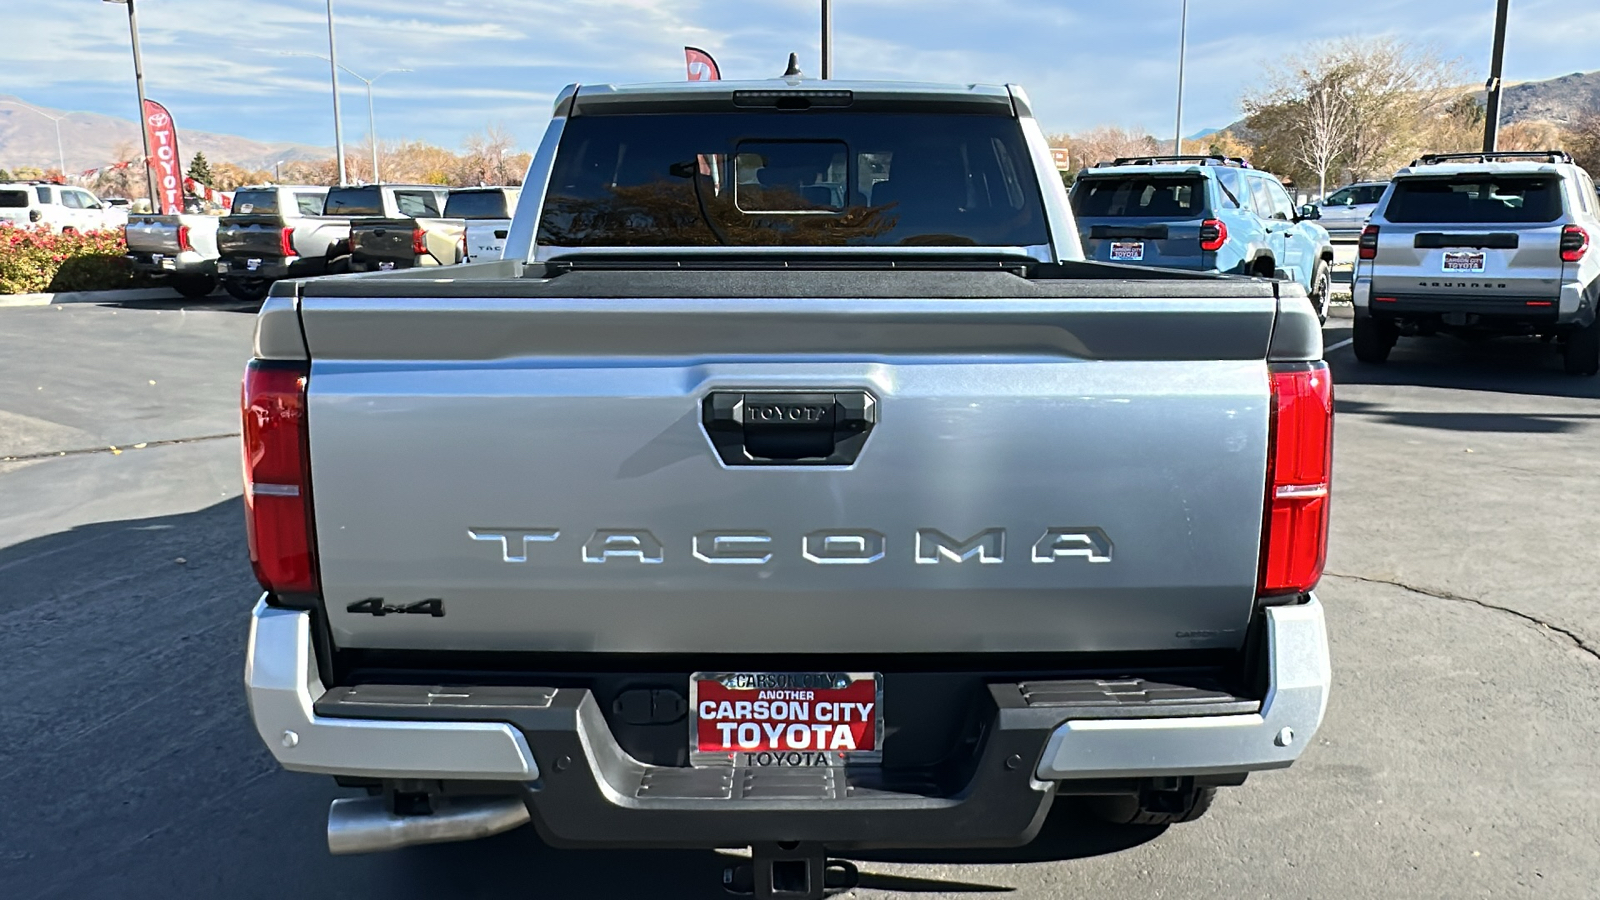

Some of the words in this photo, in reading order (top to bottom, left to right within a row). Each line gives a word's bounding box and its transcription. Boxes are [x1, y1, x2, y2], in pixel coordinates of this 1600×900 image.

[155, 131, 181, 215] TOYOTA
[747, 406, 827, 421] TOYOTA
[467, 526, 1115, 564] TACOMA
[736, 673, 797, 688] CARSON
[758, 690, 815, 700] ANOTHER
[699, 701, 809, 720] CARSON
[815, 702, 874, 722] CITY
[716, 722, 857, 750] TOYOTA
[744, 752, 828, 766] TOYOTA
